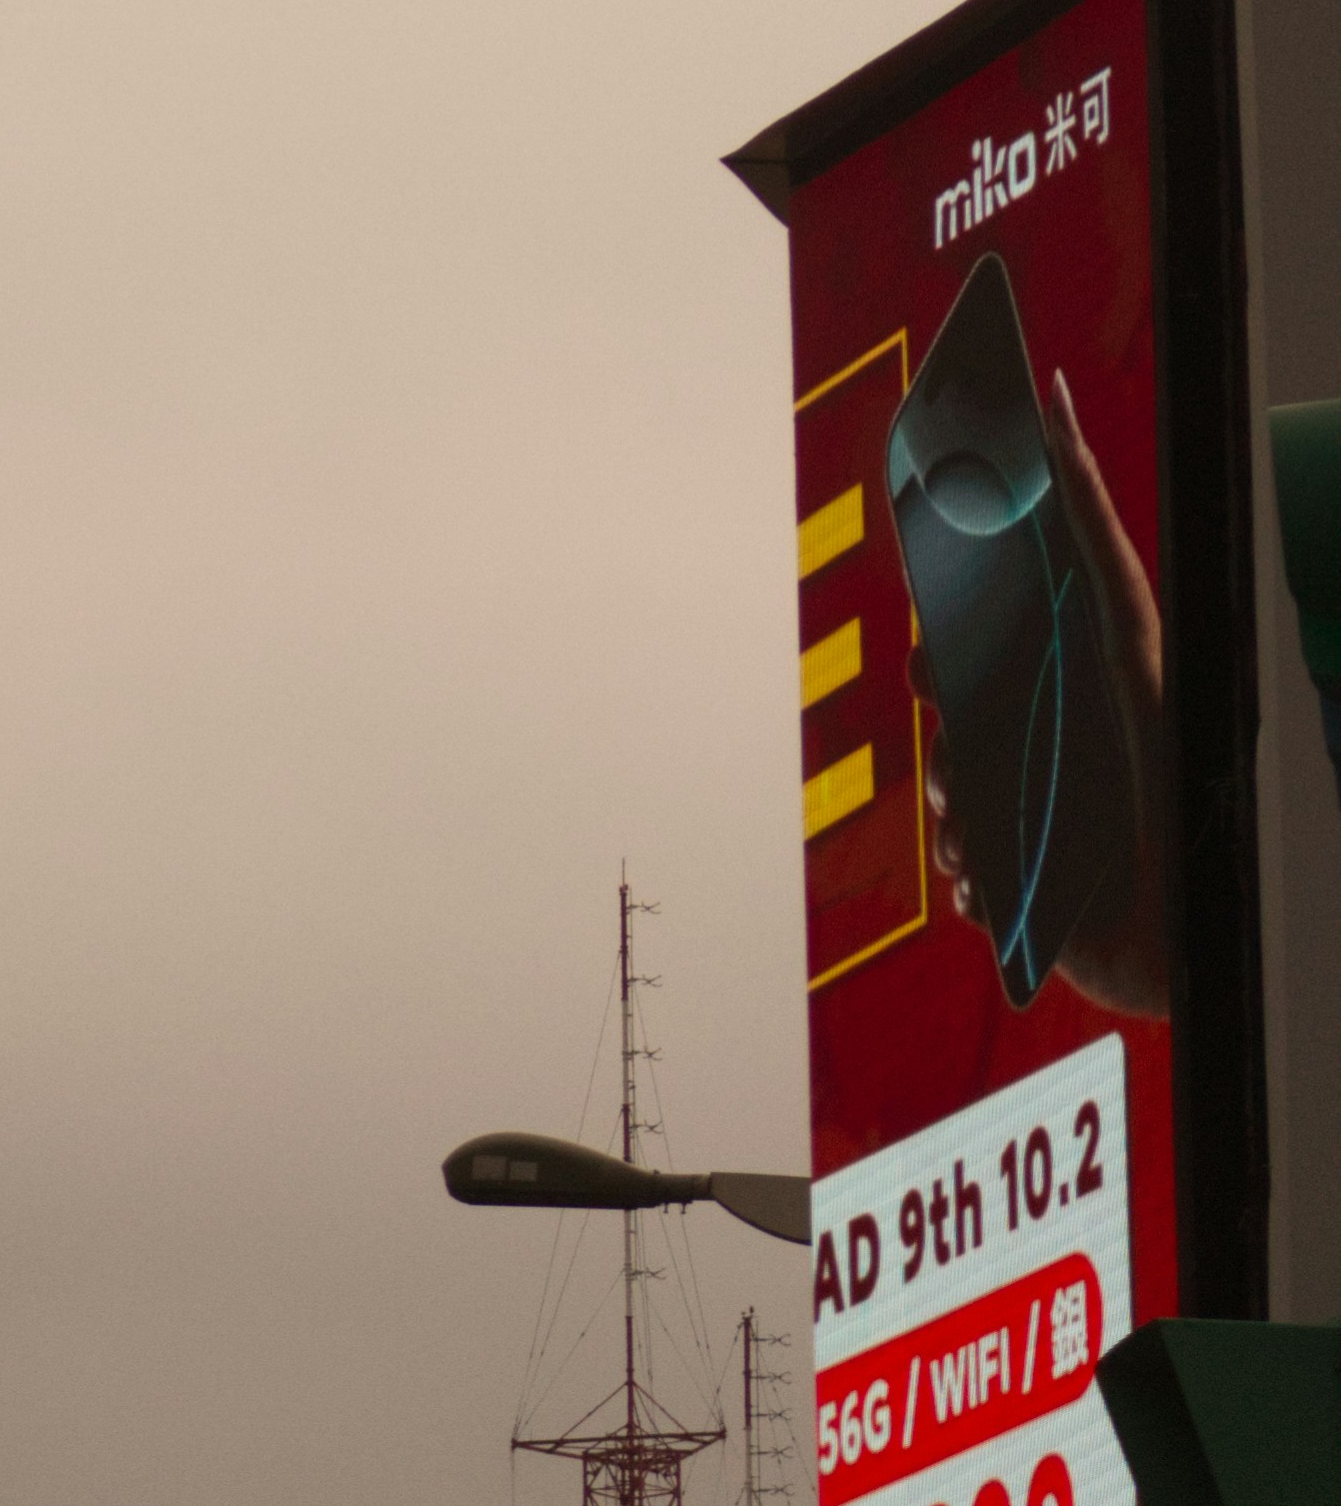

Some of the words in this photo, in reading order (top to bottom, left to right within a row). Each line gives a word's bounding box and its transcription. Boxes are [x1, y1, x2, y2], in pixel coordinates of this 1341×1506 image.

[933, 131, 1036, 250] miko
[1042, 65, 1112, 179] 米可
[898, 1160, 983, 1282] 9th
[1000, 1100, 1102, 1230] 10.2
[931, 1327, 1008, 1427] WIFI
[1049, 1279, 1088, 1377] 銀
